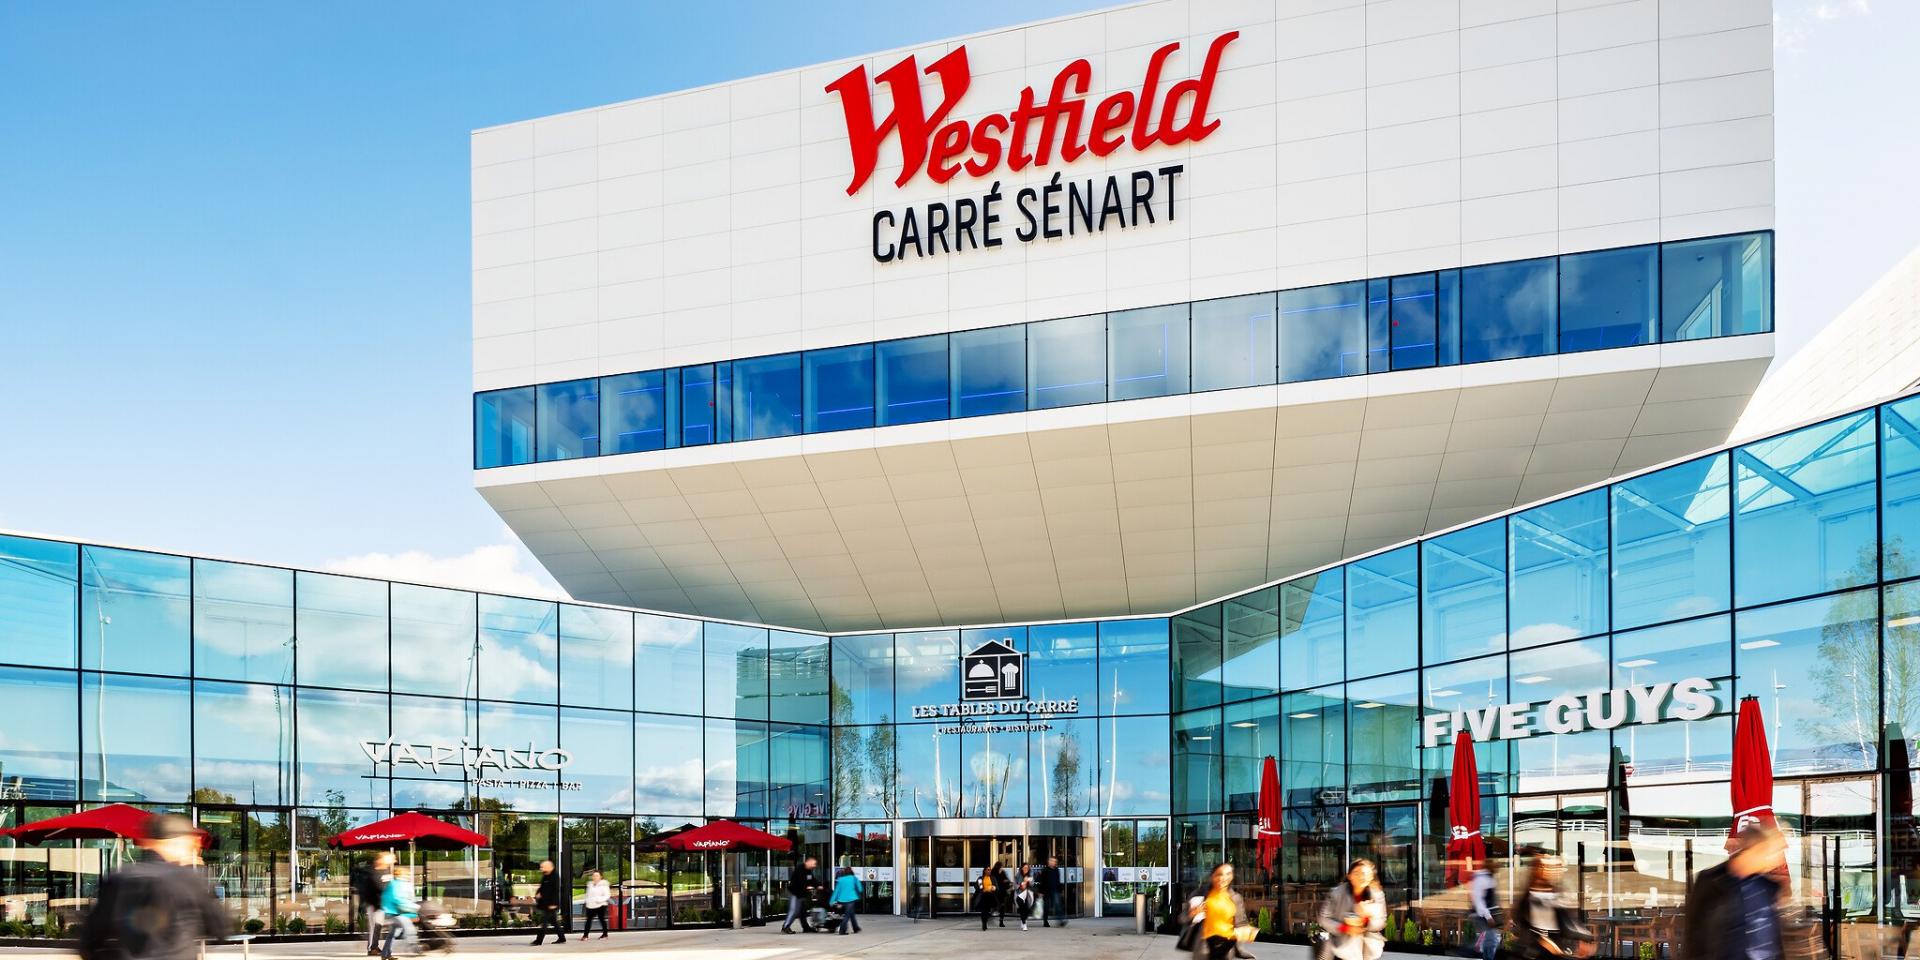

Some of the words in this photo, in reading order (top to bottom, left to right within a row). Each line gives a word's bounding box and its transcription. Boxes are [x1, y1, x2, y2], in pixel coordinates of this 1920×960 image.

[824, 31, 1240, 197] Westfield
[872, 180, 1003, 264] CARRÉ
[1015, 164, 1184, 243] SÉNART
[911, 704, 937, 718] LES
[940, 702, 995, 716] TABLES
[1000, 699, 1021, 715] DU
[1025, 695, 1078, 714] CARRÉ
[1424, 702, 1531, 748] FIVE
[1545, 677, 1717, 735] GUYS
[941, 723, 1001, 734] RESTAURANTS
[359, 734, 576, 774] VAPIANO
[472, 778, 504, 788] PASTA
[519, 780, 548, 790] PIZZA
[561, 781, 583, 792] BAR
